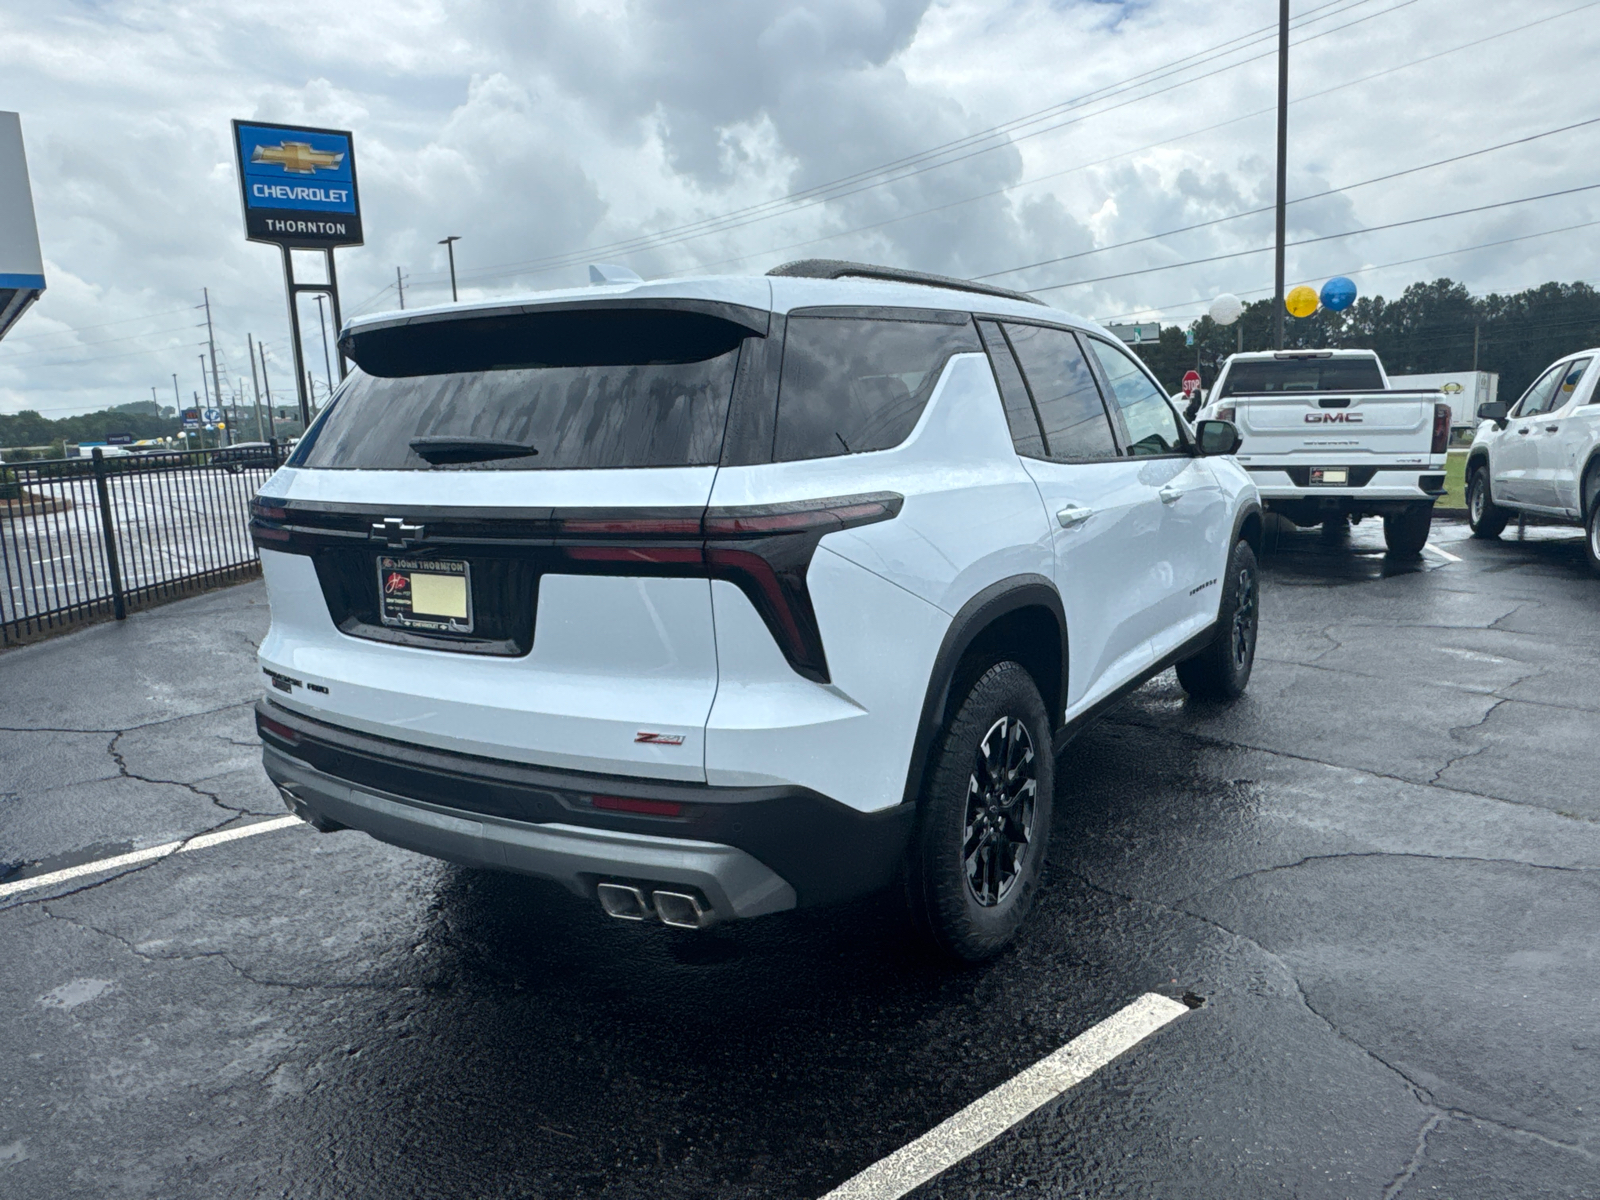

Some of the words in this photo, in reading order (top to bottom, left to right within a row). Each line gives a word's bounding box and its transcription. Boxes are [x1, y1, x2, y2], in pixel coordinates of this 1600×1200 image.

[252, 183, 349, 203] CHEVROLET
[265, 218, 347, 235] THORNTON
[1183, 380, 1200, 391] STOP
[1304, 412, 1364, 424] GMC
[396, 559, 418, 569] JOHN
[419, 560, 464, 572] THORNTON
